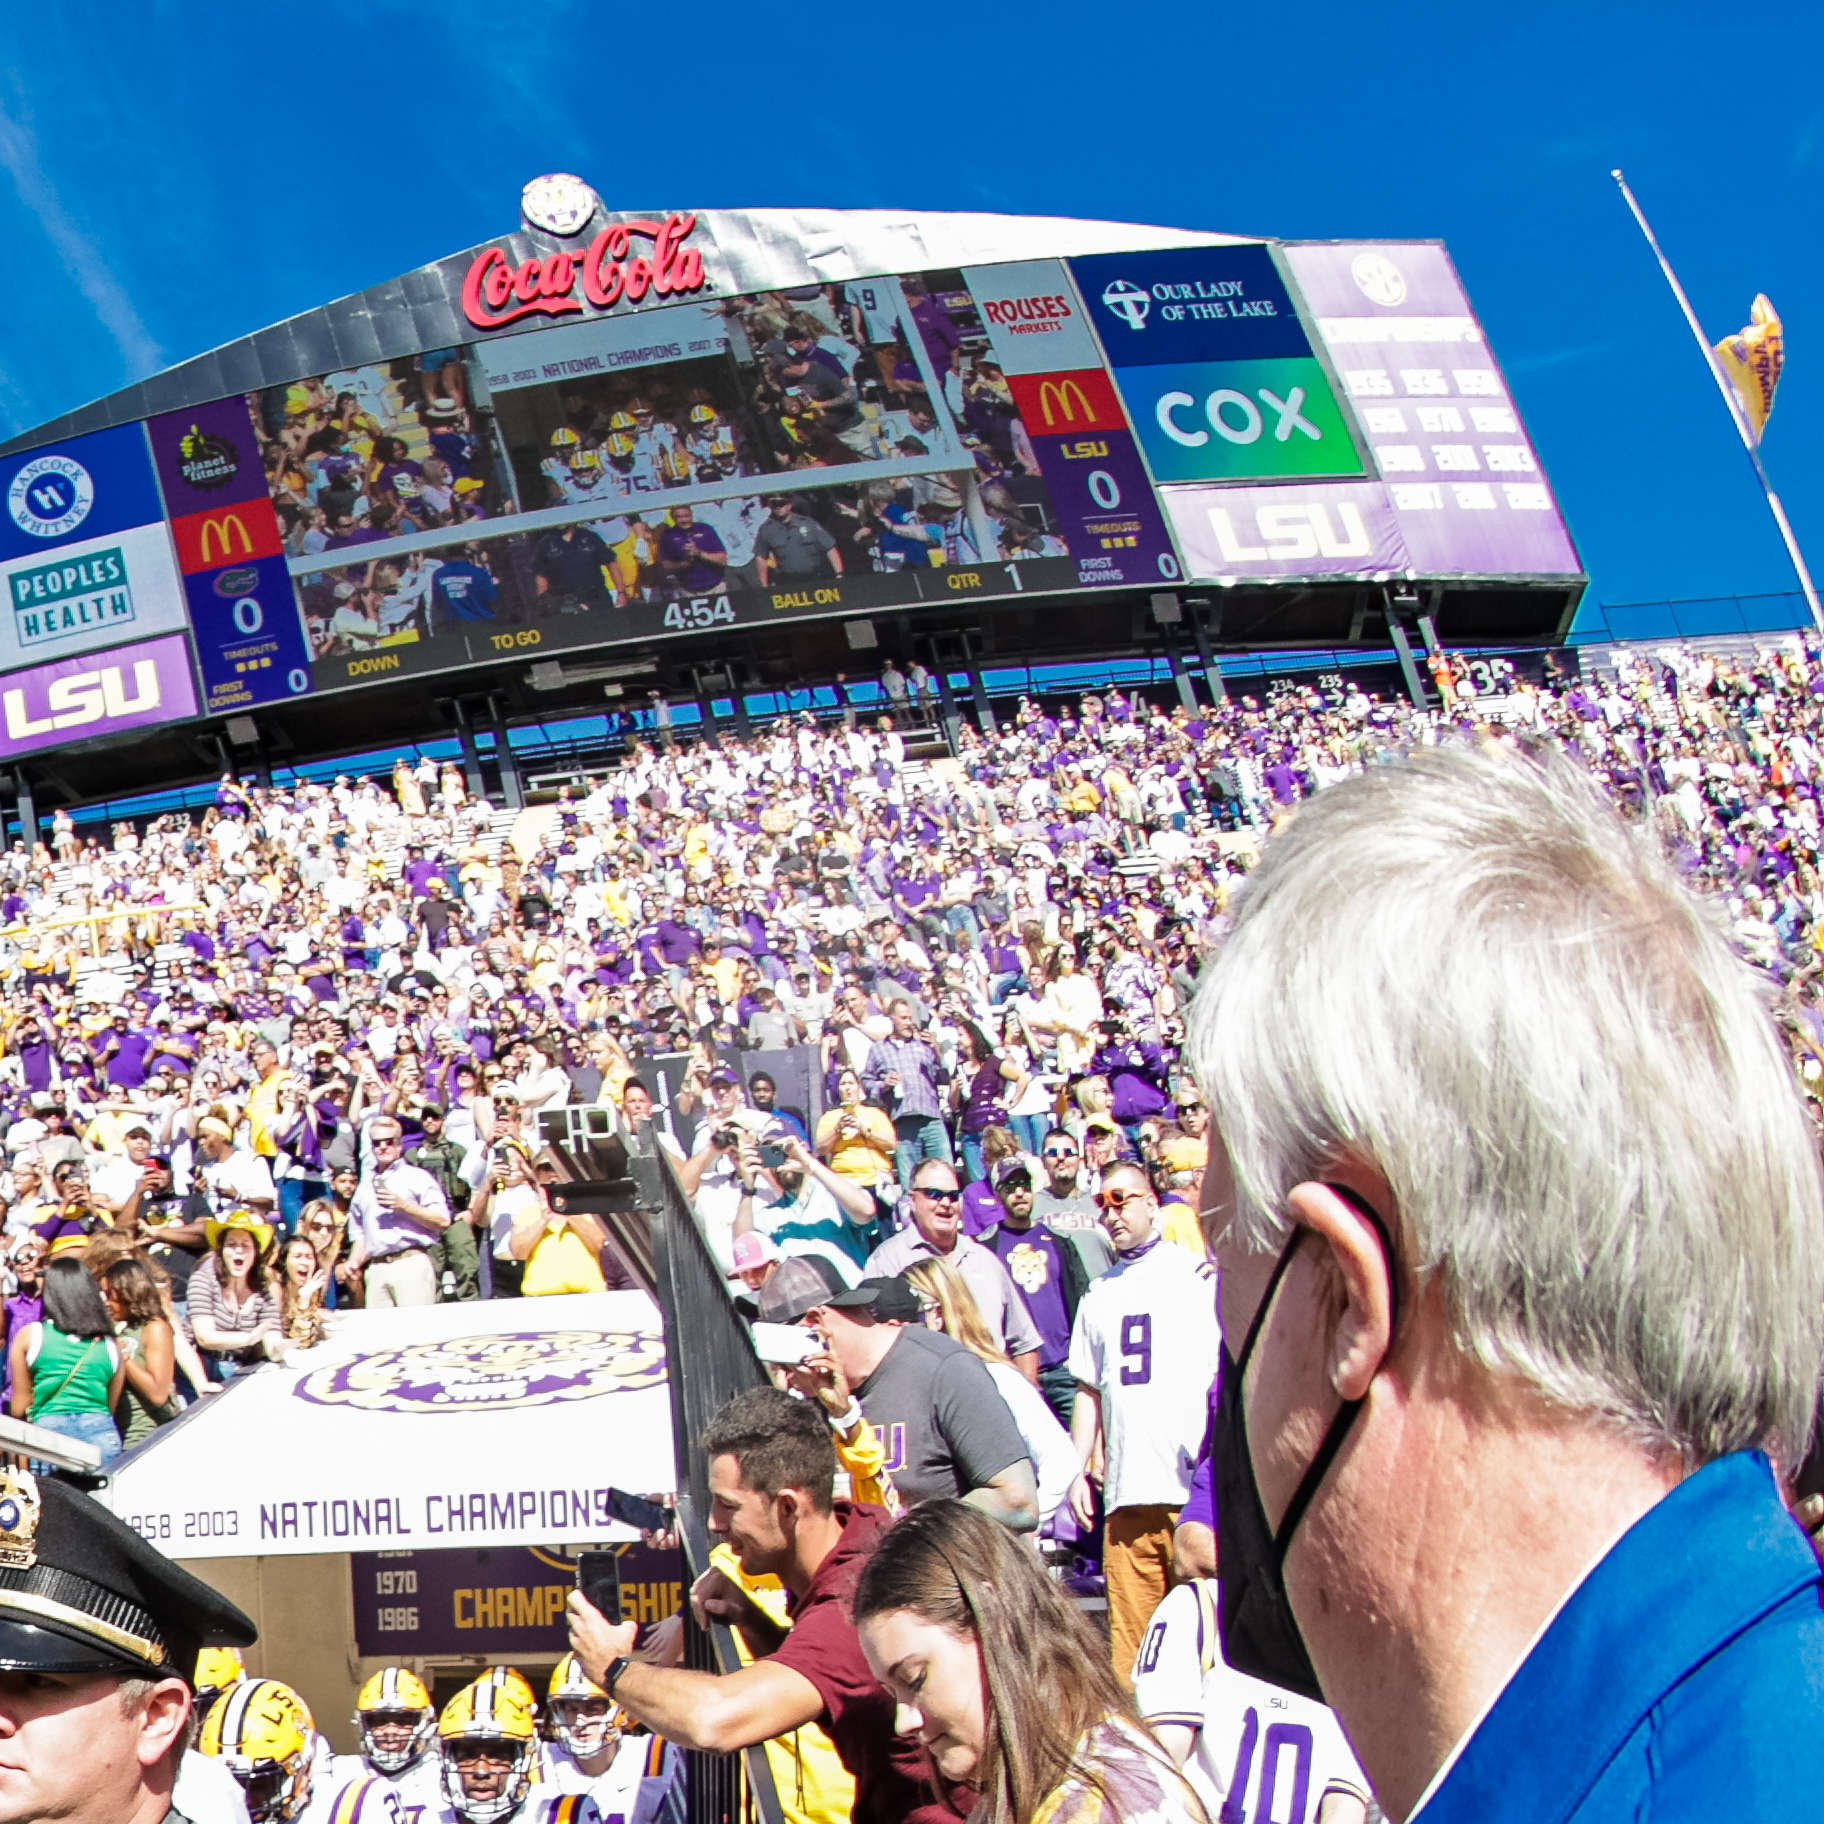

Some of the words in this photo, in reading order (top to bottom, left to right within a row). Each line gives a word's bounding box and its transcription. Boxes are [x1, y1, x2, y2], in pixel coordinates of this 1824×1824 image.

[461, 213, 706, 328] Coca-Cola
[1152, 283, 1195, 301] OUR
[1197, 281, 1244, 299] LADY
[983, 295, 1072, 324] ROUSES
[1160, 304, 1186, 322] OF
[1188, 302, 1228, 319] THE
[1230, 300, 1278, 318] LAKE
[1008, 321, 1063, 335] MARKETS
[542, 355, 603, 378] NATIONAL
[608, 343, 681, 367] CHAMPIONS
[1155, 386, 1322, 447] COX
[1061, 441, 1109, 459] LSU
[12, 459, 85, 497] HANCOCK
[182, 455, 225, 477] planet
[190, 463, 238, 481] fitness
[1088, 470, 1121, 510] 0
[18, 496, 89, 534] WHITNEY
[1207, 502, 1374, 563] LSU
[1078, 570, 1124, 583] DOWNS
[1080, 557, 1113, 570] FIRST
[1156, 553, 1178, 579] 0
[16, 556, 120, 601] PEOPLES
[947, 573, 981, 590] QTR
[1004, 563, 1023, 591] 1
[772, 592, 812, 610] BALL
[814, 587, 841, 606] ON
[25, 592, 128, 637] HEALTH
[232, 597, 263, 634] 0
[663, 595, 736, 630] 4:54
[490, 632, 514, 650] TO
[517, 629, 542, 647] GO
[347, 654, 400, 676] DOWN
[213, 680, 243, 695] FIRST
[287, 668, 308, 692] 0
[1318, 674, 1344, 689] 235
[2, 659, 160, 739] LSU
[1120, 1314, 1151, 1386] 9
[123, 1515, 172, 1541] 958
[184, 1510, 240, 1537] 2003
[259, 1497, 412, 1540] NATIONAL
[425, 1488, 613, 1533] CHAMPIONS
[376, 1570, 418, 1595] 1970
[377, 1607, 419, 1631] 1986
